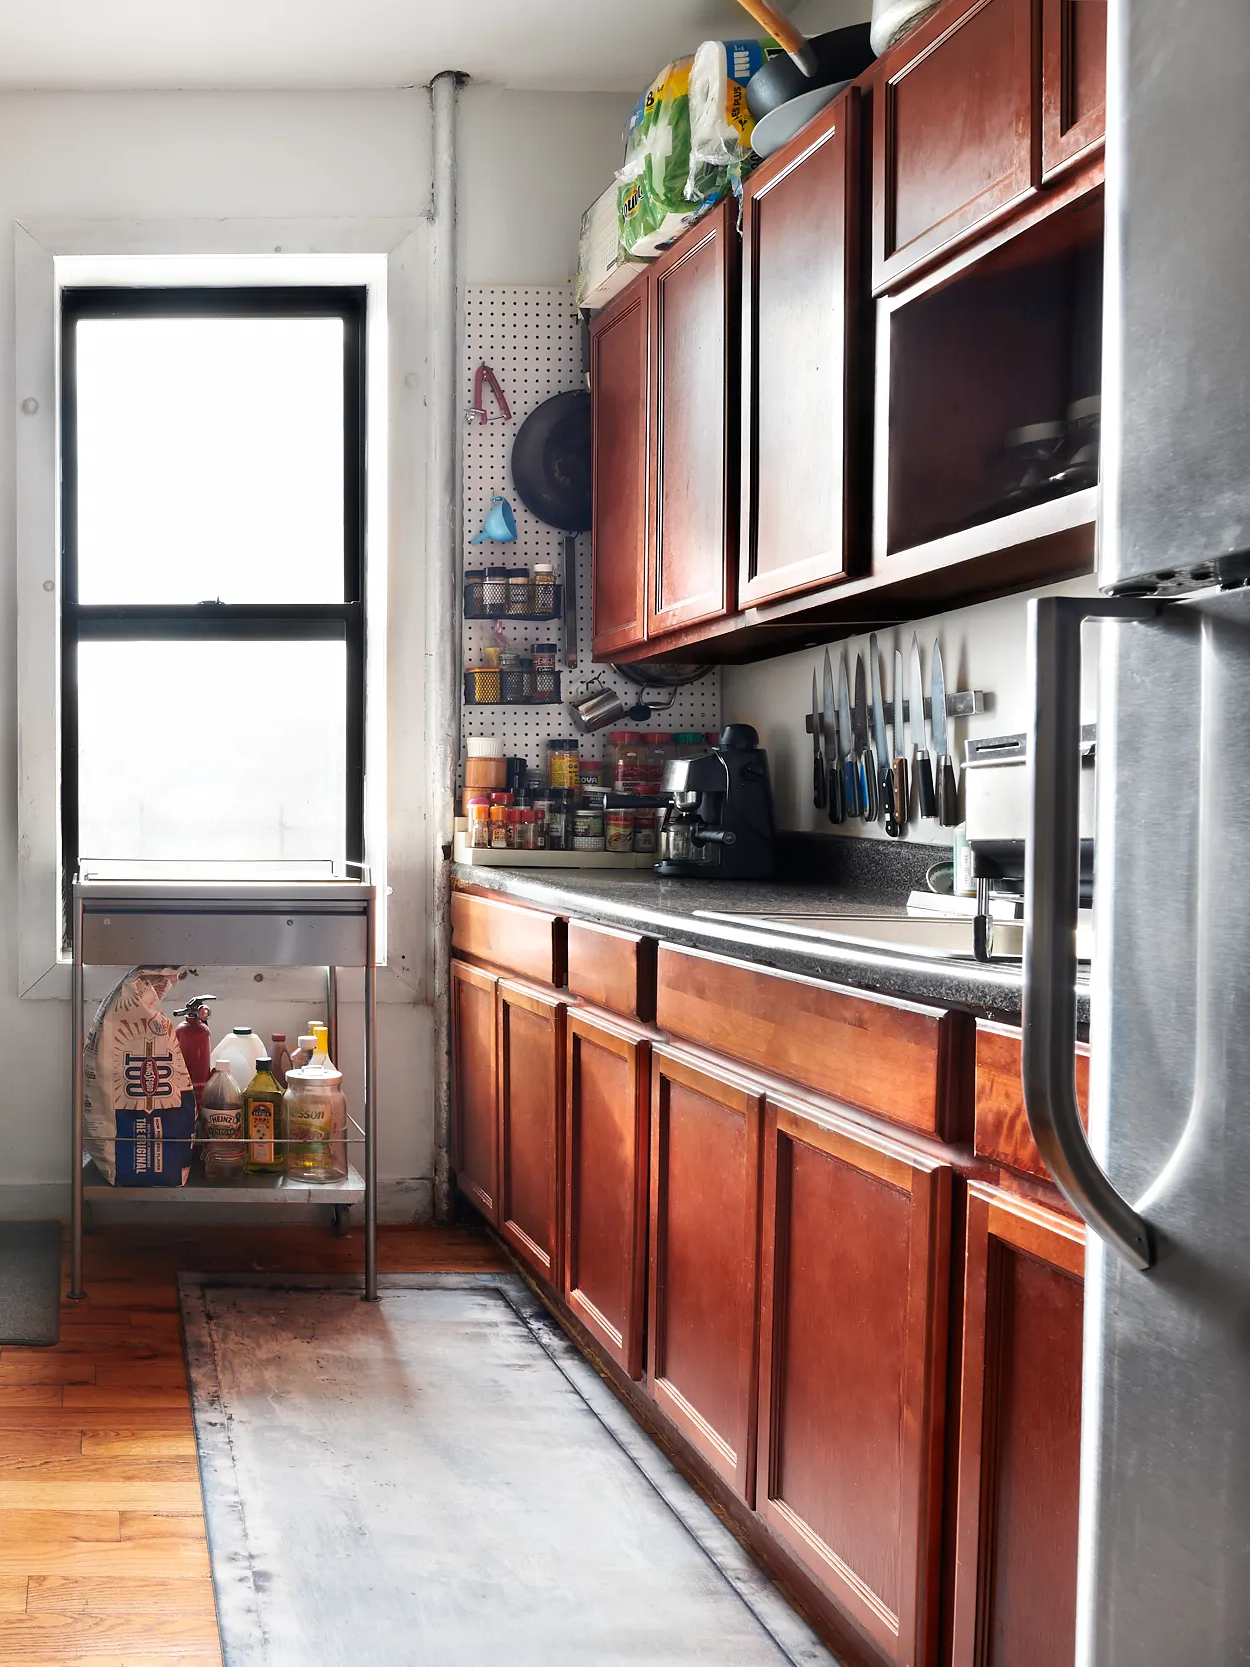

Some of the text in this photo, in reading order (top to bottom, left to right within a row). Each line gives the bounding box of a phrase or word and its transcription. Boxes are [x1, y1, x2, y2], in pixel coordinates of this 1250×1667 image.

[733, 86, 742, 106] PLUS
[125, 1052, 173, 1097] 100
[144, 1061, 156, 1092] KINGSFORD
[211, 1114, 233, 1123] HEINZ
[210, 1128, 235, 1136] VINEGAR
[136, 1117, 147, 1174] THE ORIGINAL
